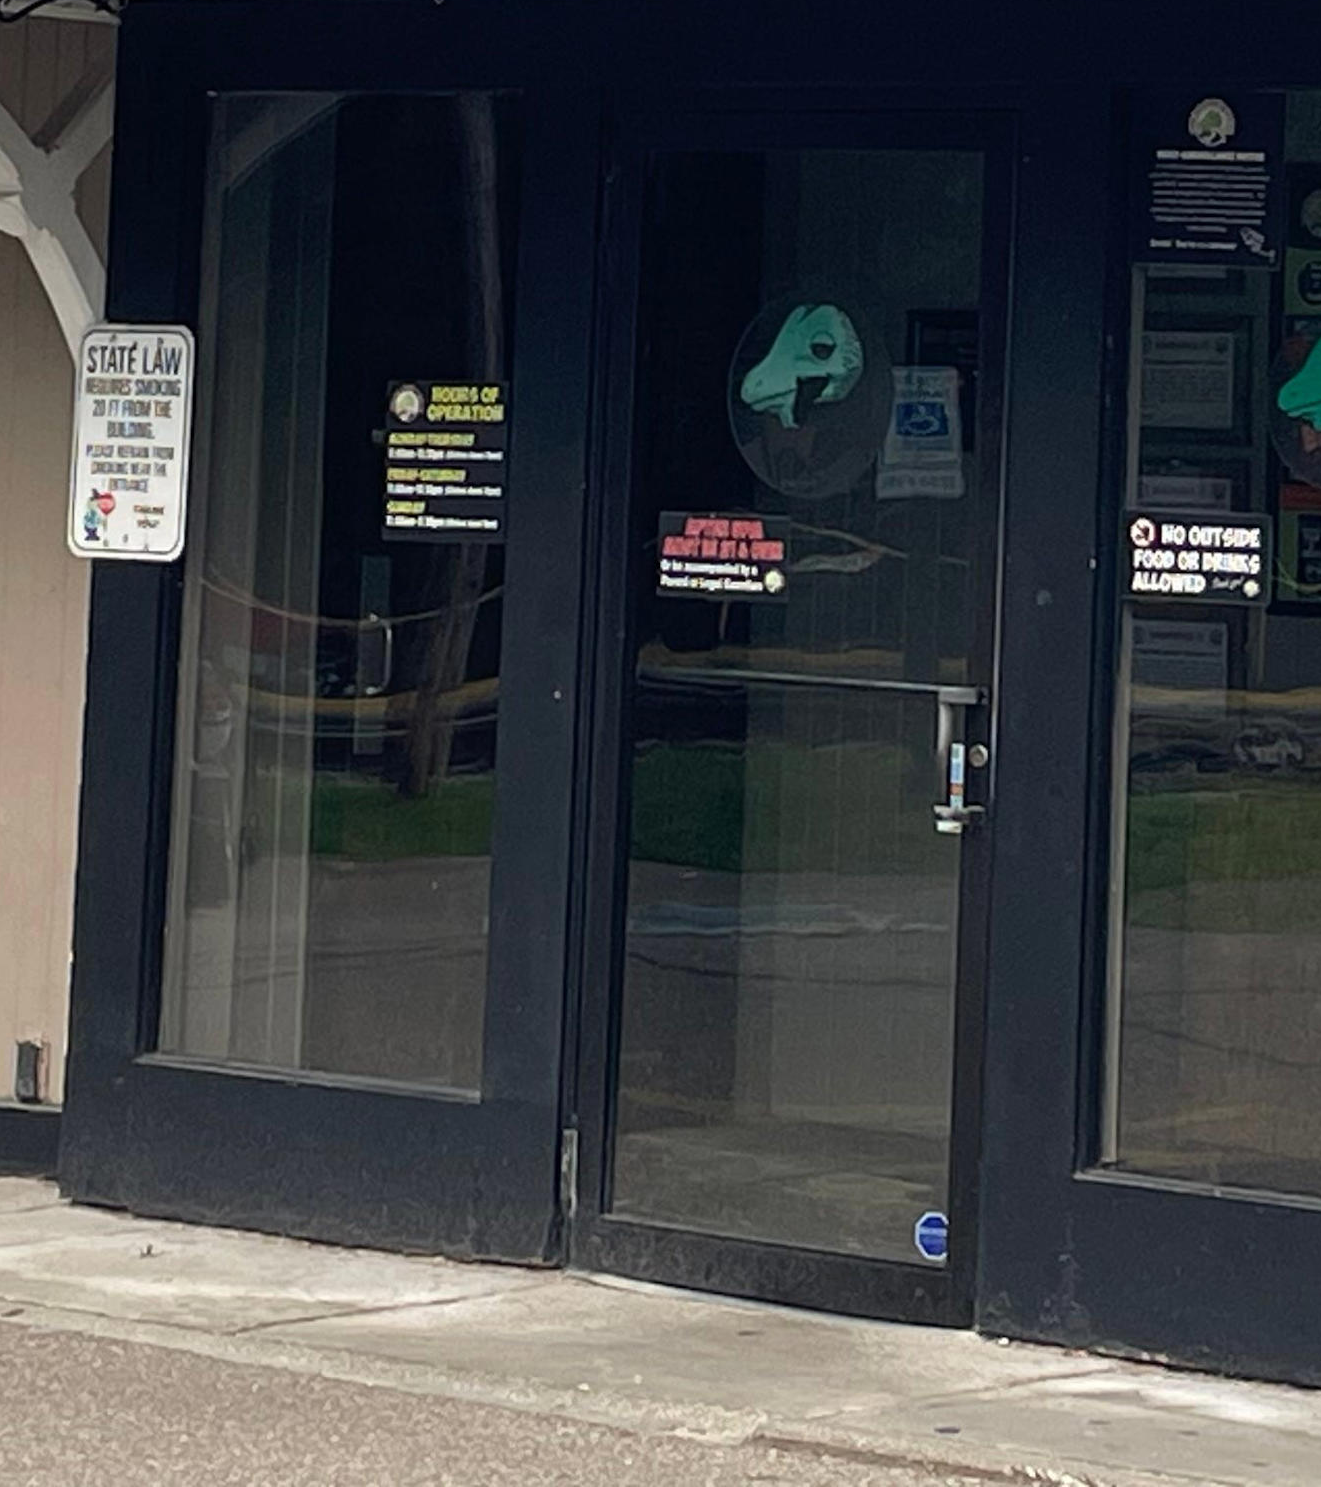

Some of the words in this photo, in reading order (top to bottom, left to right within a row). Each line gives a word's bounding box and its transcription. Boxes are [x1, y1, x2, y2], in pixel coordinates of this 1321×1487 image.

[87, 345, 136, 374] STATE
[142, 347, 182, 375] LAW
[431, 386, 479, 403] HOURS
[480, 386, 499, 403] OF
[427, 403, 505, 421] OPERATION
[1161, 523, 1186, 545] NO
[1188, 525, 1261, 548] OUTSIDE
[1133, 549, 1175, 569] FOOD
[1177, 550, 1200, 571] OR
[1202, 552, 1261, 575] DRINKS
[1131, 571, 1206, 593] ALLOWED
